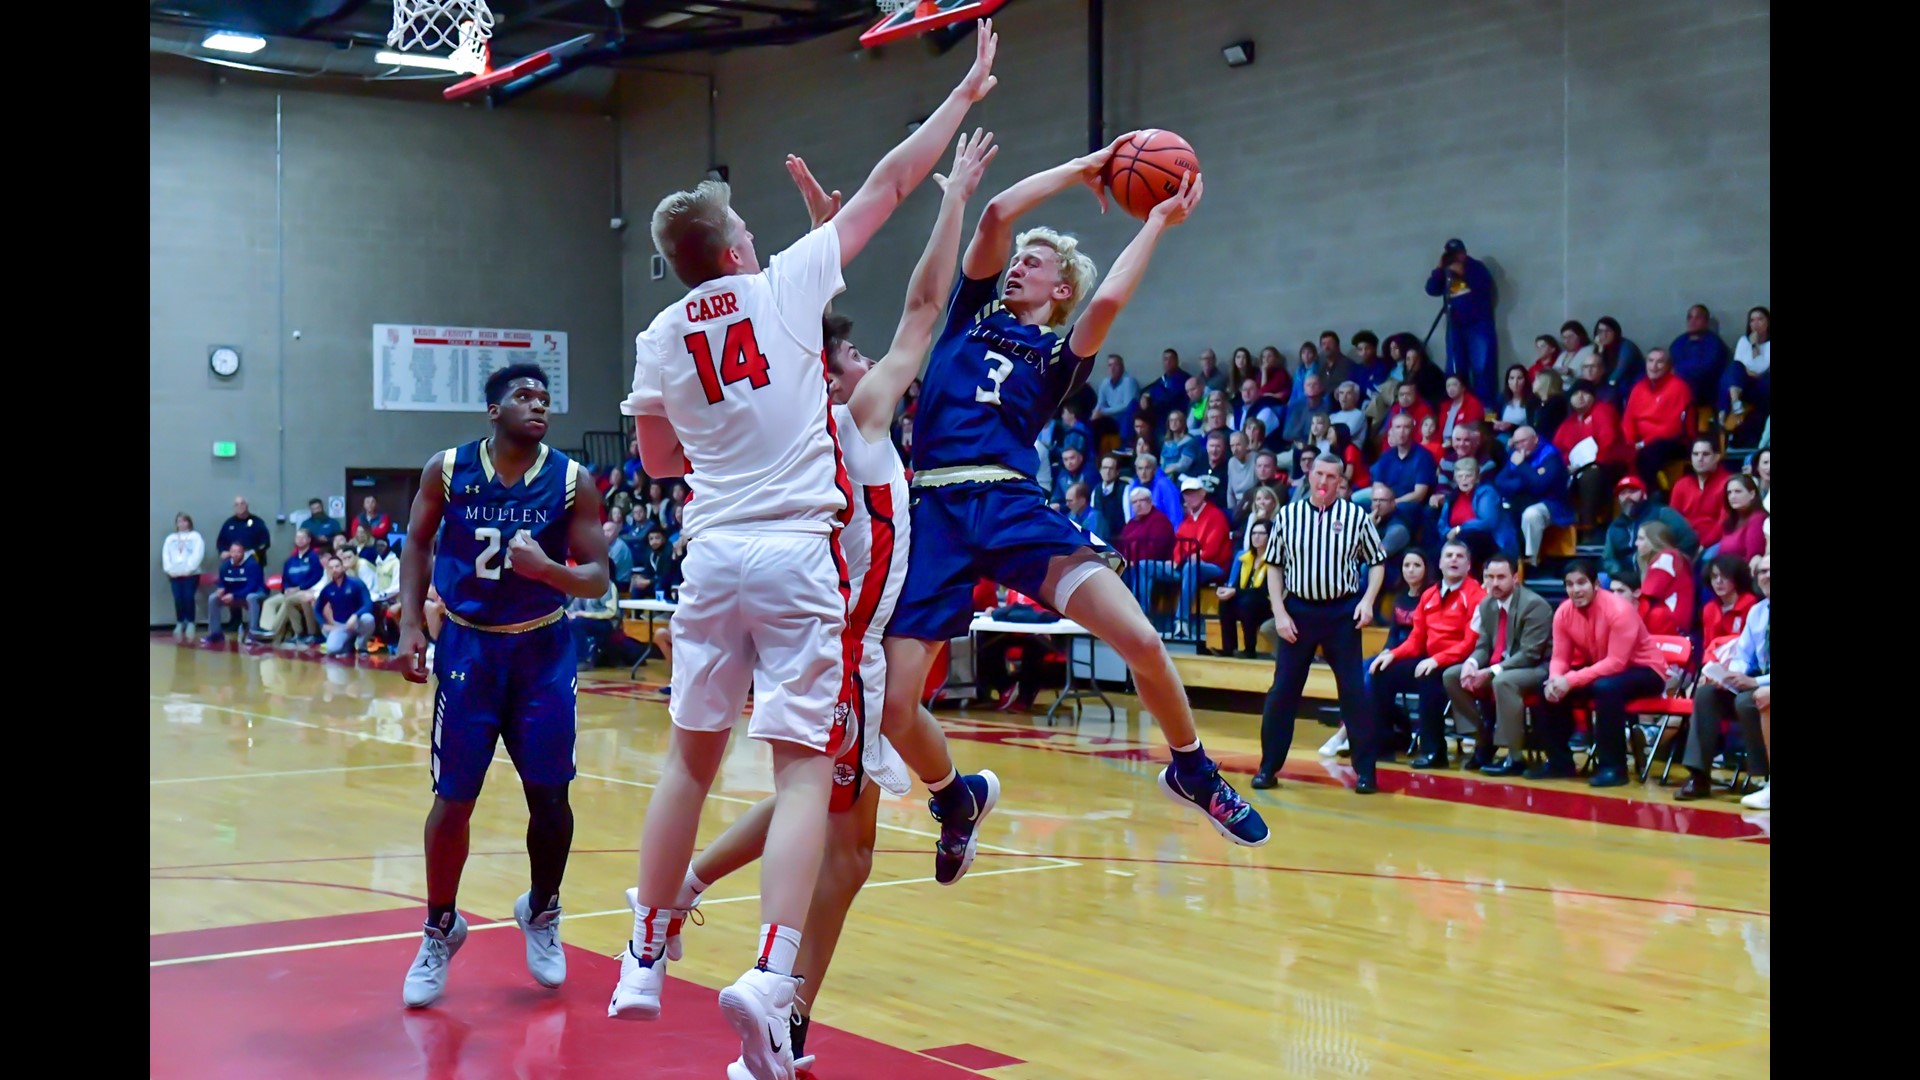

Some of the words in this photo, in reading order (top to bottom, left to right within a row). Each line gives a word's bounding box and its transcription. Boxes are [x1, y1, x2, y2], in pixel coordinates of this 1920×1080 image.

[686, 292, 739, 322] CARR
[683, 317, 771, 405] 14
[975, 350, 1013, 405] 3
[465, 506, 548, 523] MULLEN
